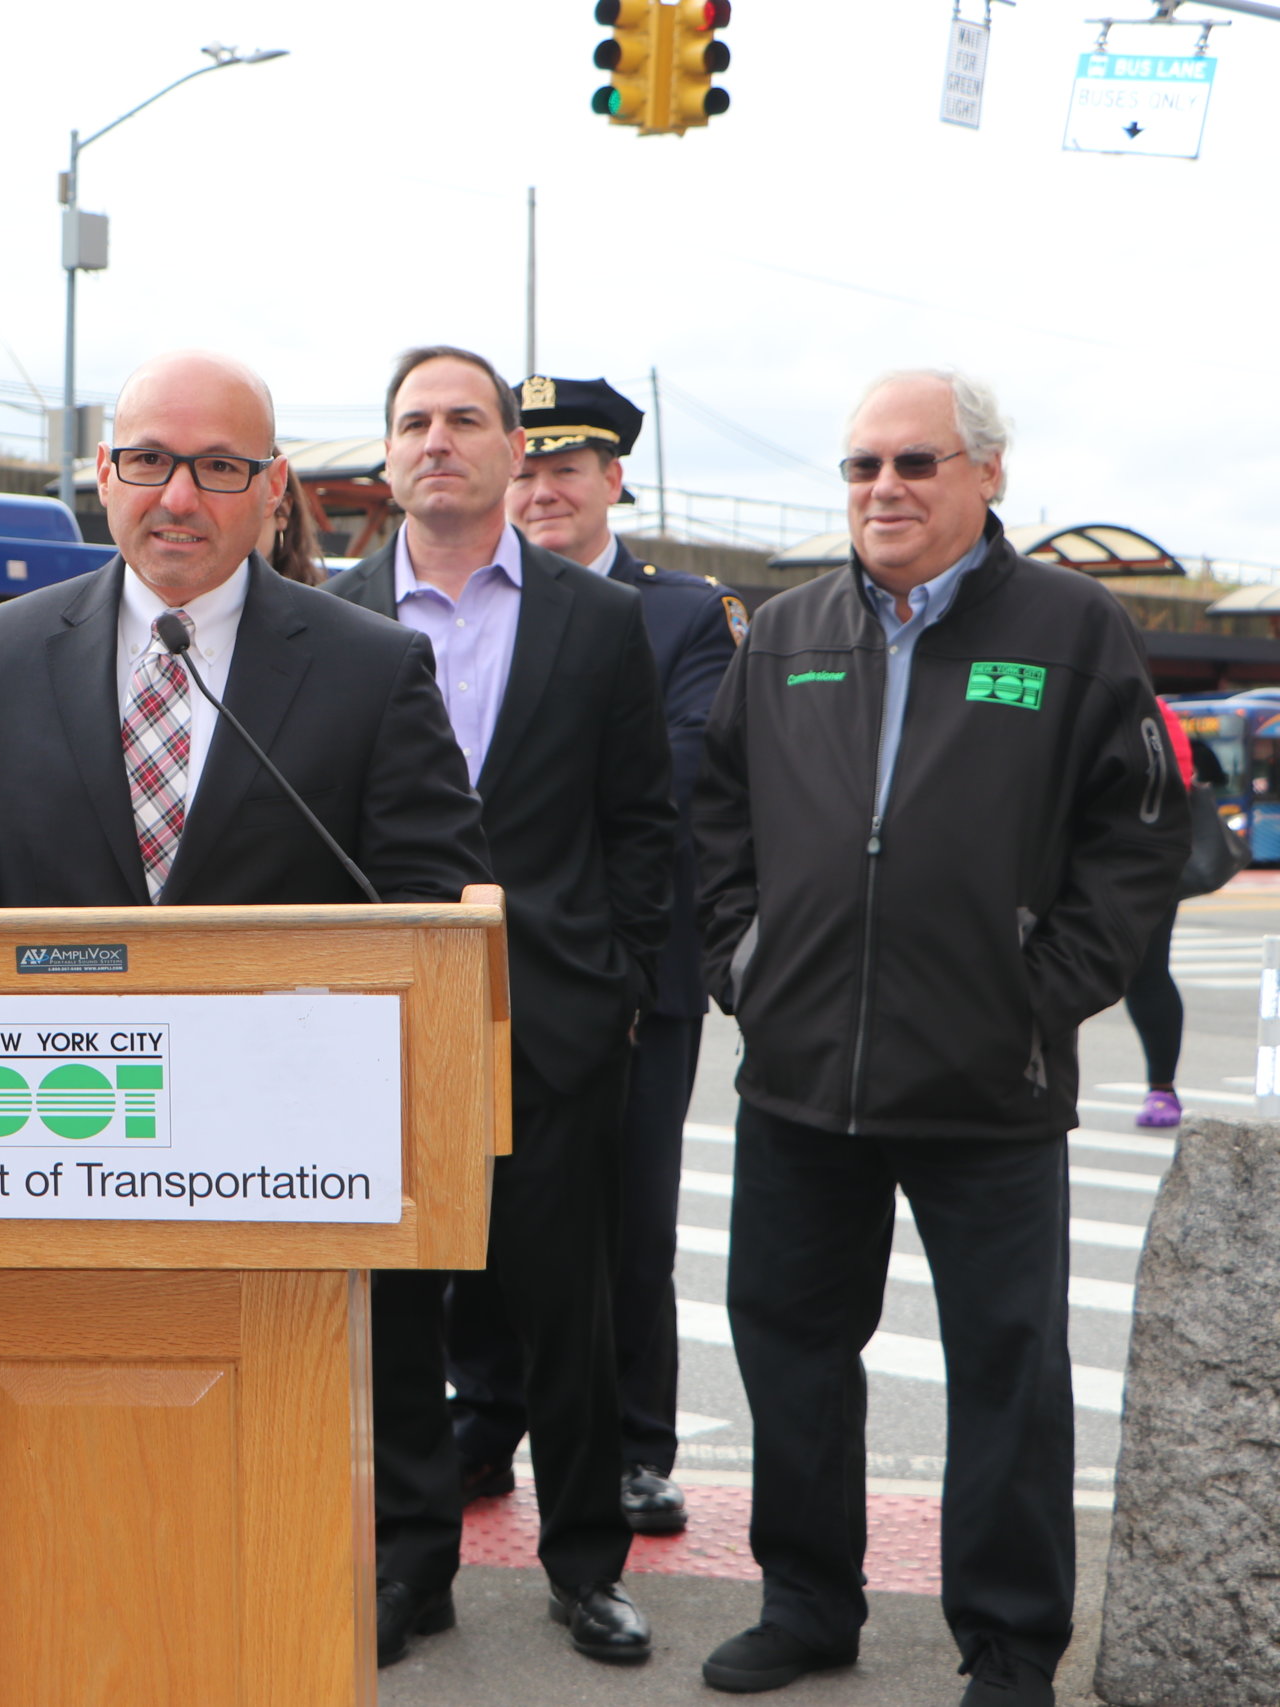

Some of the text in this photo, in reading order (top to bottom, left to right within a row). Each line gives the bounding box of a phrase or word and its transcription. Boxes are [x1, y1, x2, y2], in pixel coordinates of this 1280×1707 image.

[957, 26, 981, 49] WAIT
[954, 50, 977, 73] FOR
[1114, 57, 1207, 80] BUS LANE
[946, 73, 980, 97] GREEN
[945, 96, 976, 120] LIGHT
[1078, 88, 1199, 112] BUSES ONLY
[37, 1032, 99, 1052] YORK
[110, 1032, 163, 1052] CITY
[25, 1162, 64, 1197] of
[76, 1162, 370, 1207] Transportation
